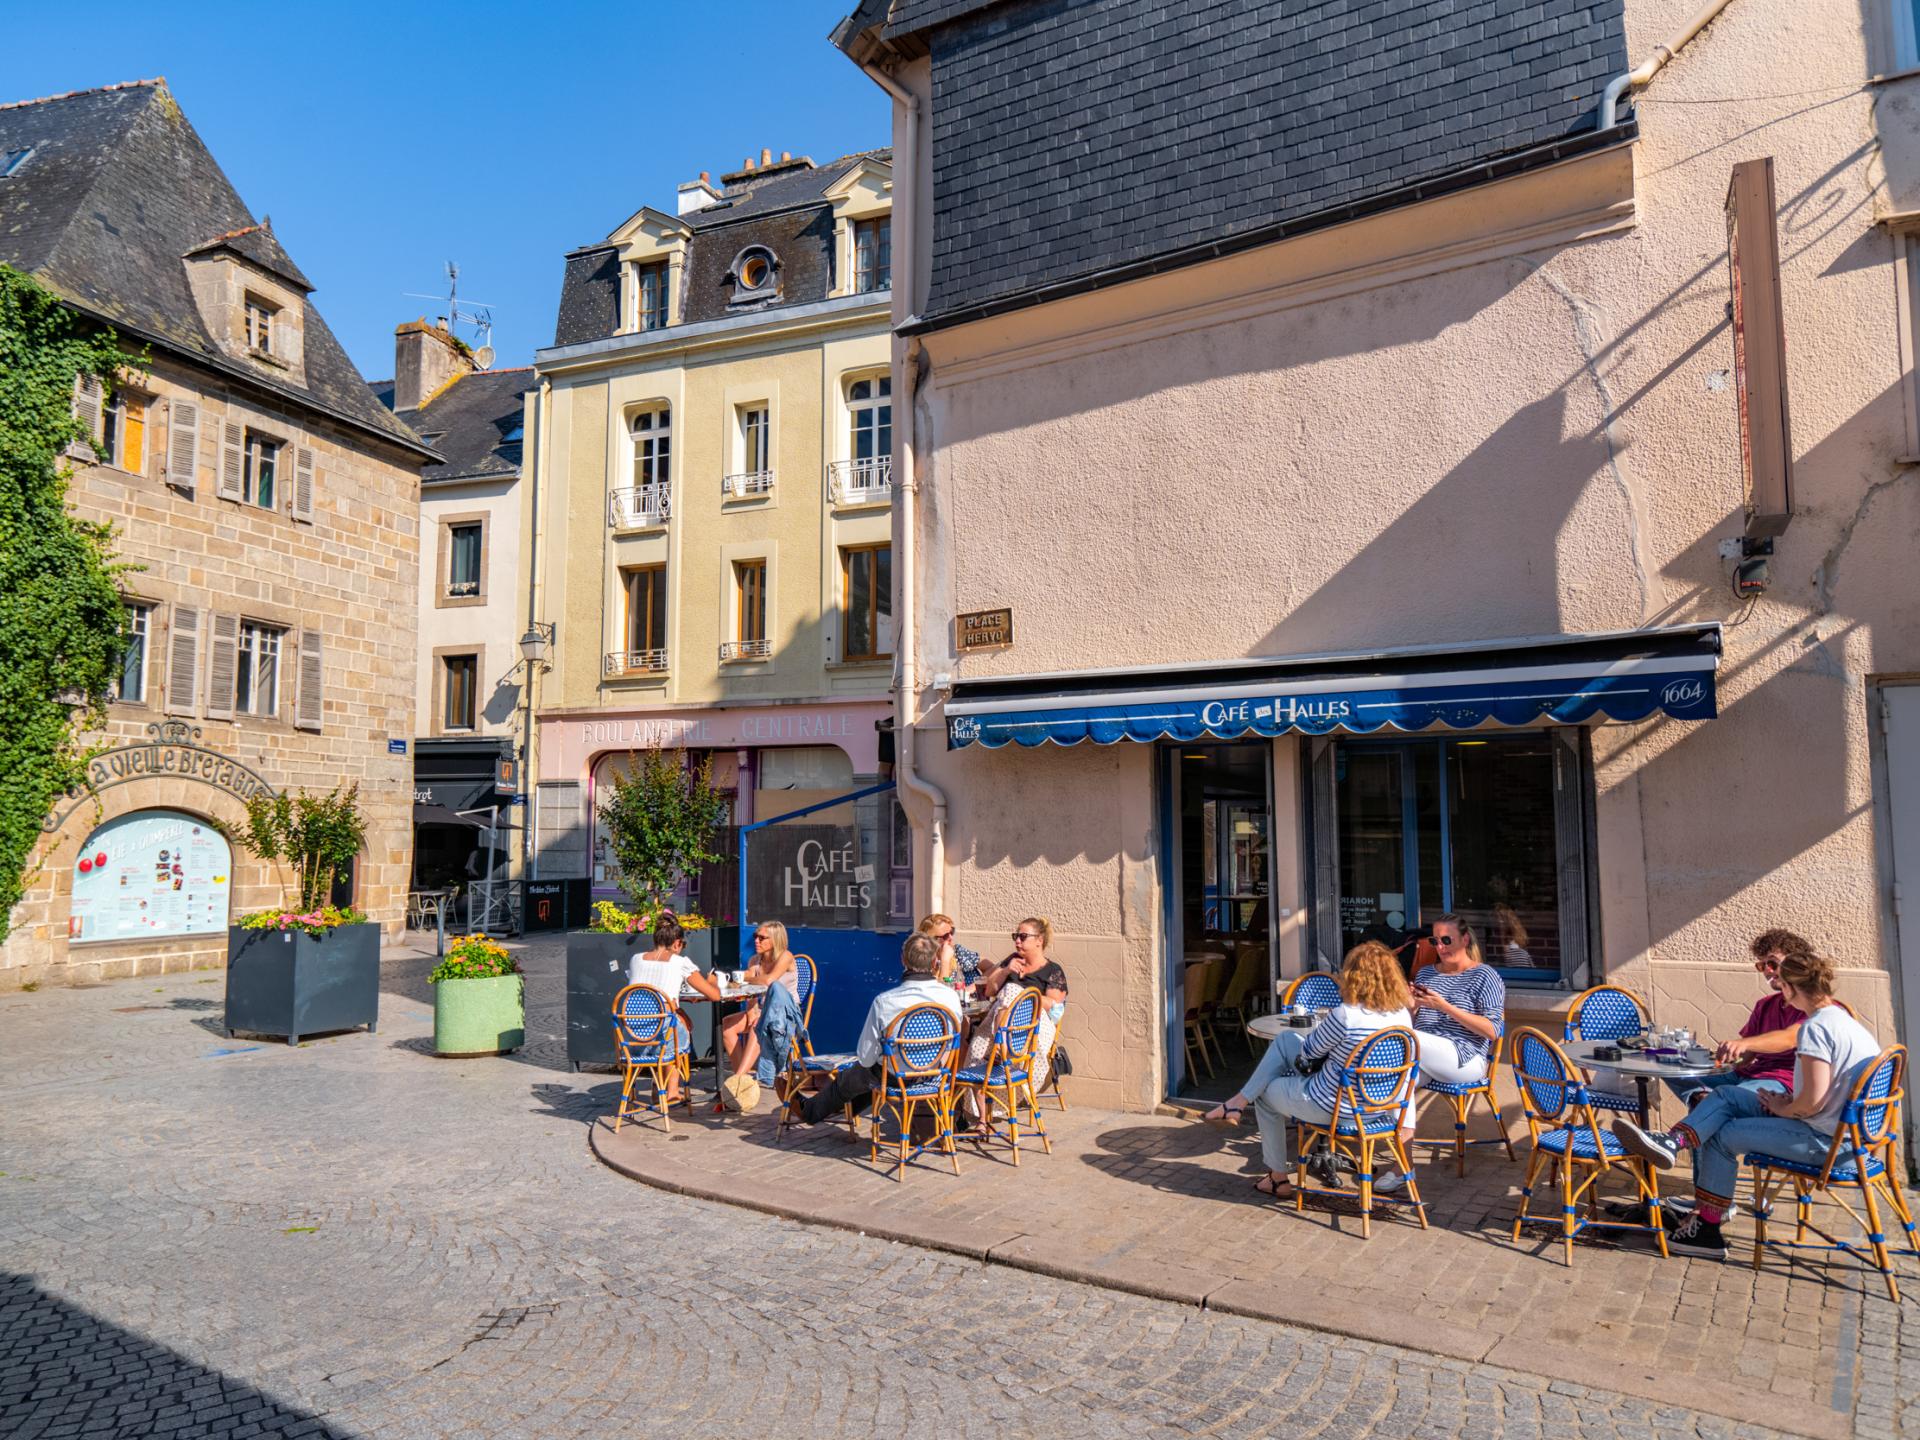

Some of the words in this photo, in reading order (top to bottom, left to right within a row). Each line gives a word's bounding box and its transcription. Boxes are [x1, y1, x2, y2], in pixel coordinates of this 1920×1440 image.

[967, 614, 1002, 628] PLACE
[1665, 681, 1704, 704] 1664
[1202, 701, 1249, 727] CAFÉ
[1275, 698, 1350, 723] HALLES
[582, 718, 713, 744] BOULANGERIE
[742, 714, 854, 739] CENTRALE
[797, 840, 853, 881] CAFÉ
[784, 867, 871, 909] HALLES
